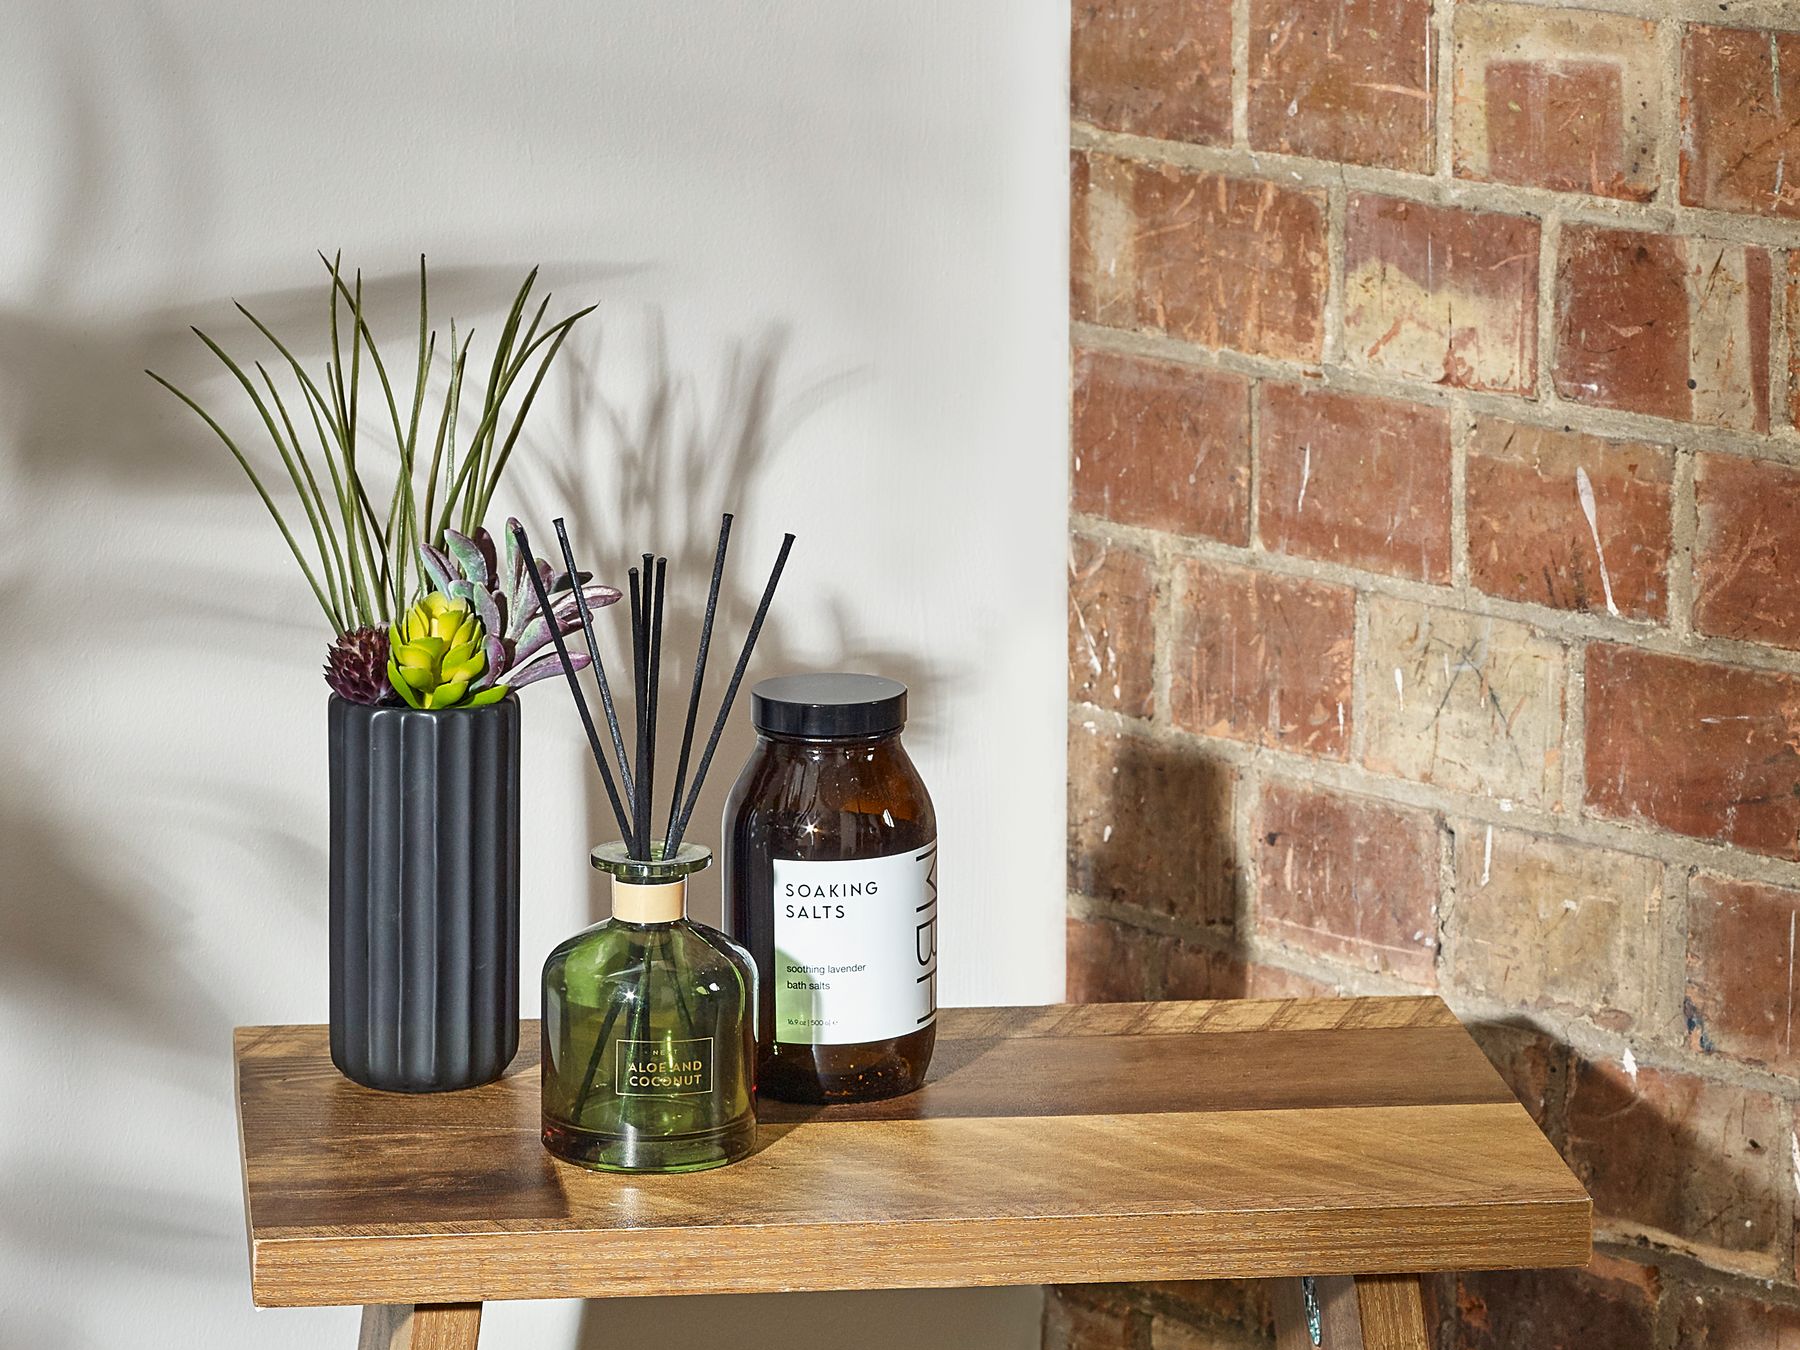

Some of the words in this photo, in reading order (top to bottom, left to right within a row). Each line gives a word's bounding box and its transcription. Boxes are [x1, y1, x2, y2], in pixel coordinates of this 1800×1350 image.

[785, 881, 879, 898] SOAKING
[785, 905, 846, 919] SALTS
[786, 965, 825, 976] soothing
[827, 963, 867, 974] lavender
[786, 981, 807, 990] bath
[808, 981, 831, 990] salts
[628, 1061, 667, 1073] ALOE
[672, 1060, 703, 1073] AND
[629, 1074, 702, 1087] COCONUT
